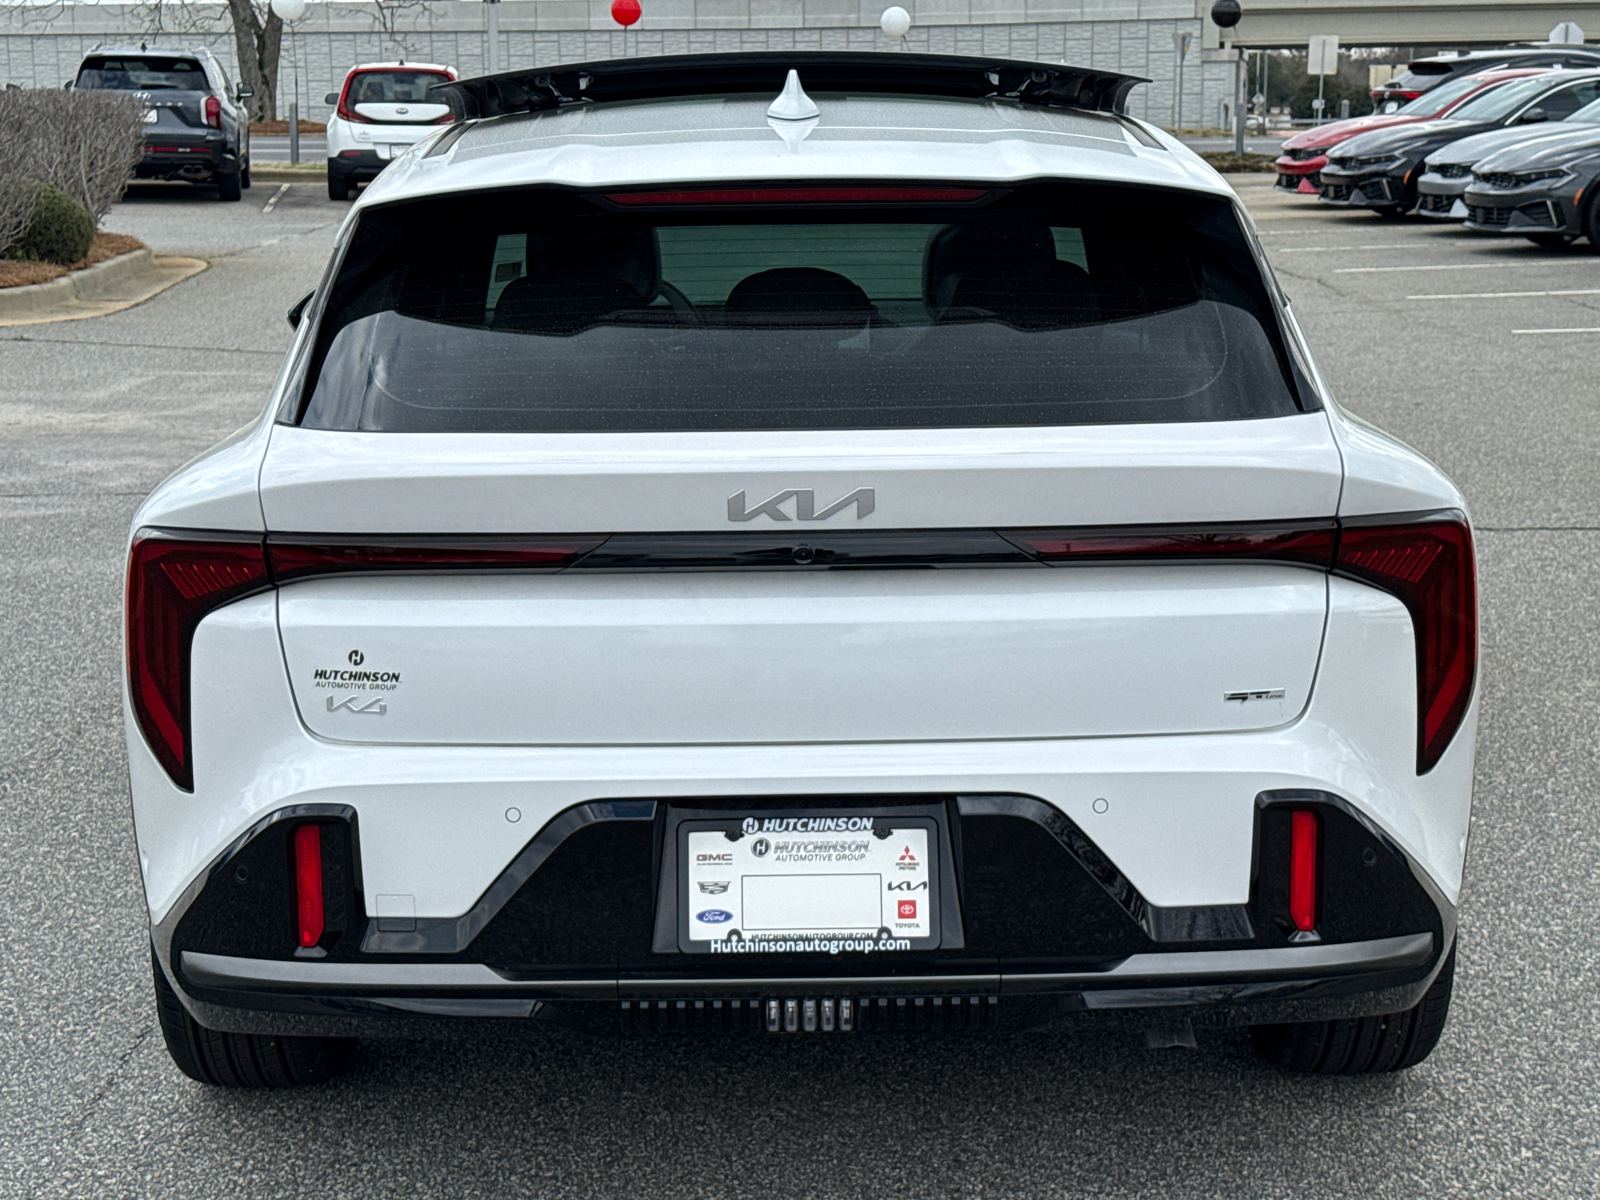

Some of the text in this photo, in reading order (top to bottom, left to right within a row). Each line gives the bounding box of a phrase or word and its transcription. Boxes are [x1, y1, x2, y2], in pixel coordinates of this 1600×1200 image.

[728, 486, 875, 522] KIA
[313, 668, 401, 683] HUTCHINSON
[315, 680, 398, 692] AUTOMOTIVE GROUP
[325, 693, 387, 717] K4
[762, 817, 874, 832] HUTCHINSON
[773, 840, 870, 854] HUTCHINSON
[696, 853, 733, 862] GMC
[775, 852, 866, 862] AUTOMOTIVE GROUP
[887, 880, 928, 892] KIA
[703, 911, 726, 921] Ford
[751, 931, 874, 940] HUTCHINSONAUTOGROUPCOM
[710, 938, 911, 954] Hutchinsonautogroup.com
